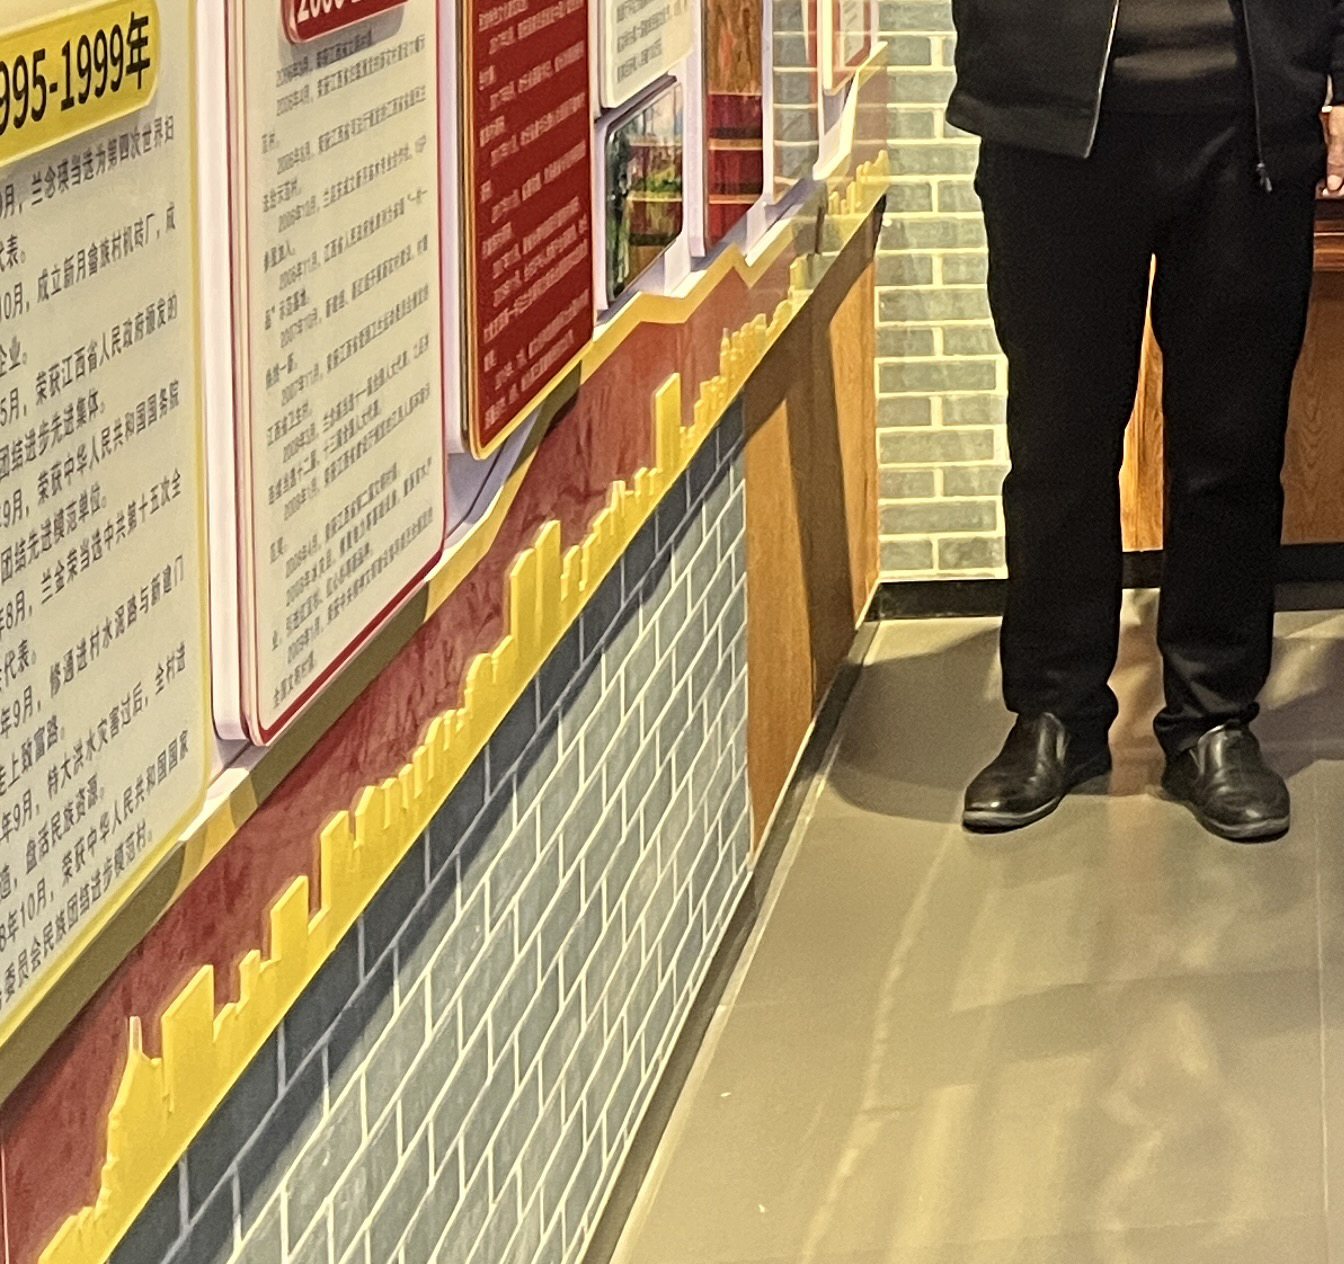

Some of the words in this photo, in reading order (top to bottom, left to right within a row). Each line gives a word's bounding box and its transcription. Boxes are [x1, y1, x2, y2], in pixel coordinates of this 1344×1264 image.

[0, 379, 179, 529] 9月，荣获中华人民共和国国务院
[0, 640, 36, 688] 代表。
[0, 818, 152, 1009] 委员会民族团结进步模范村。
